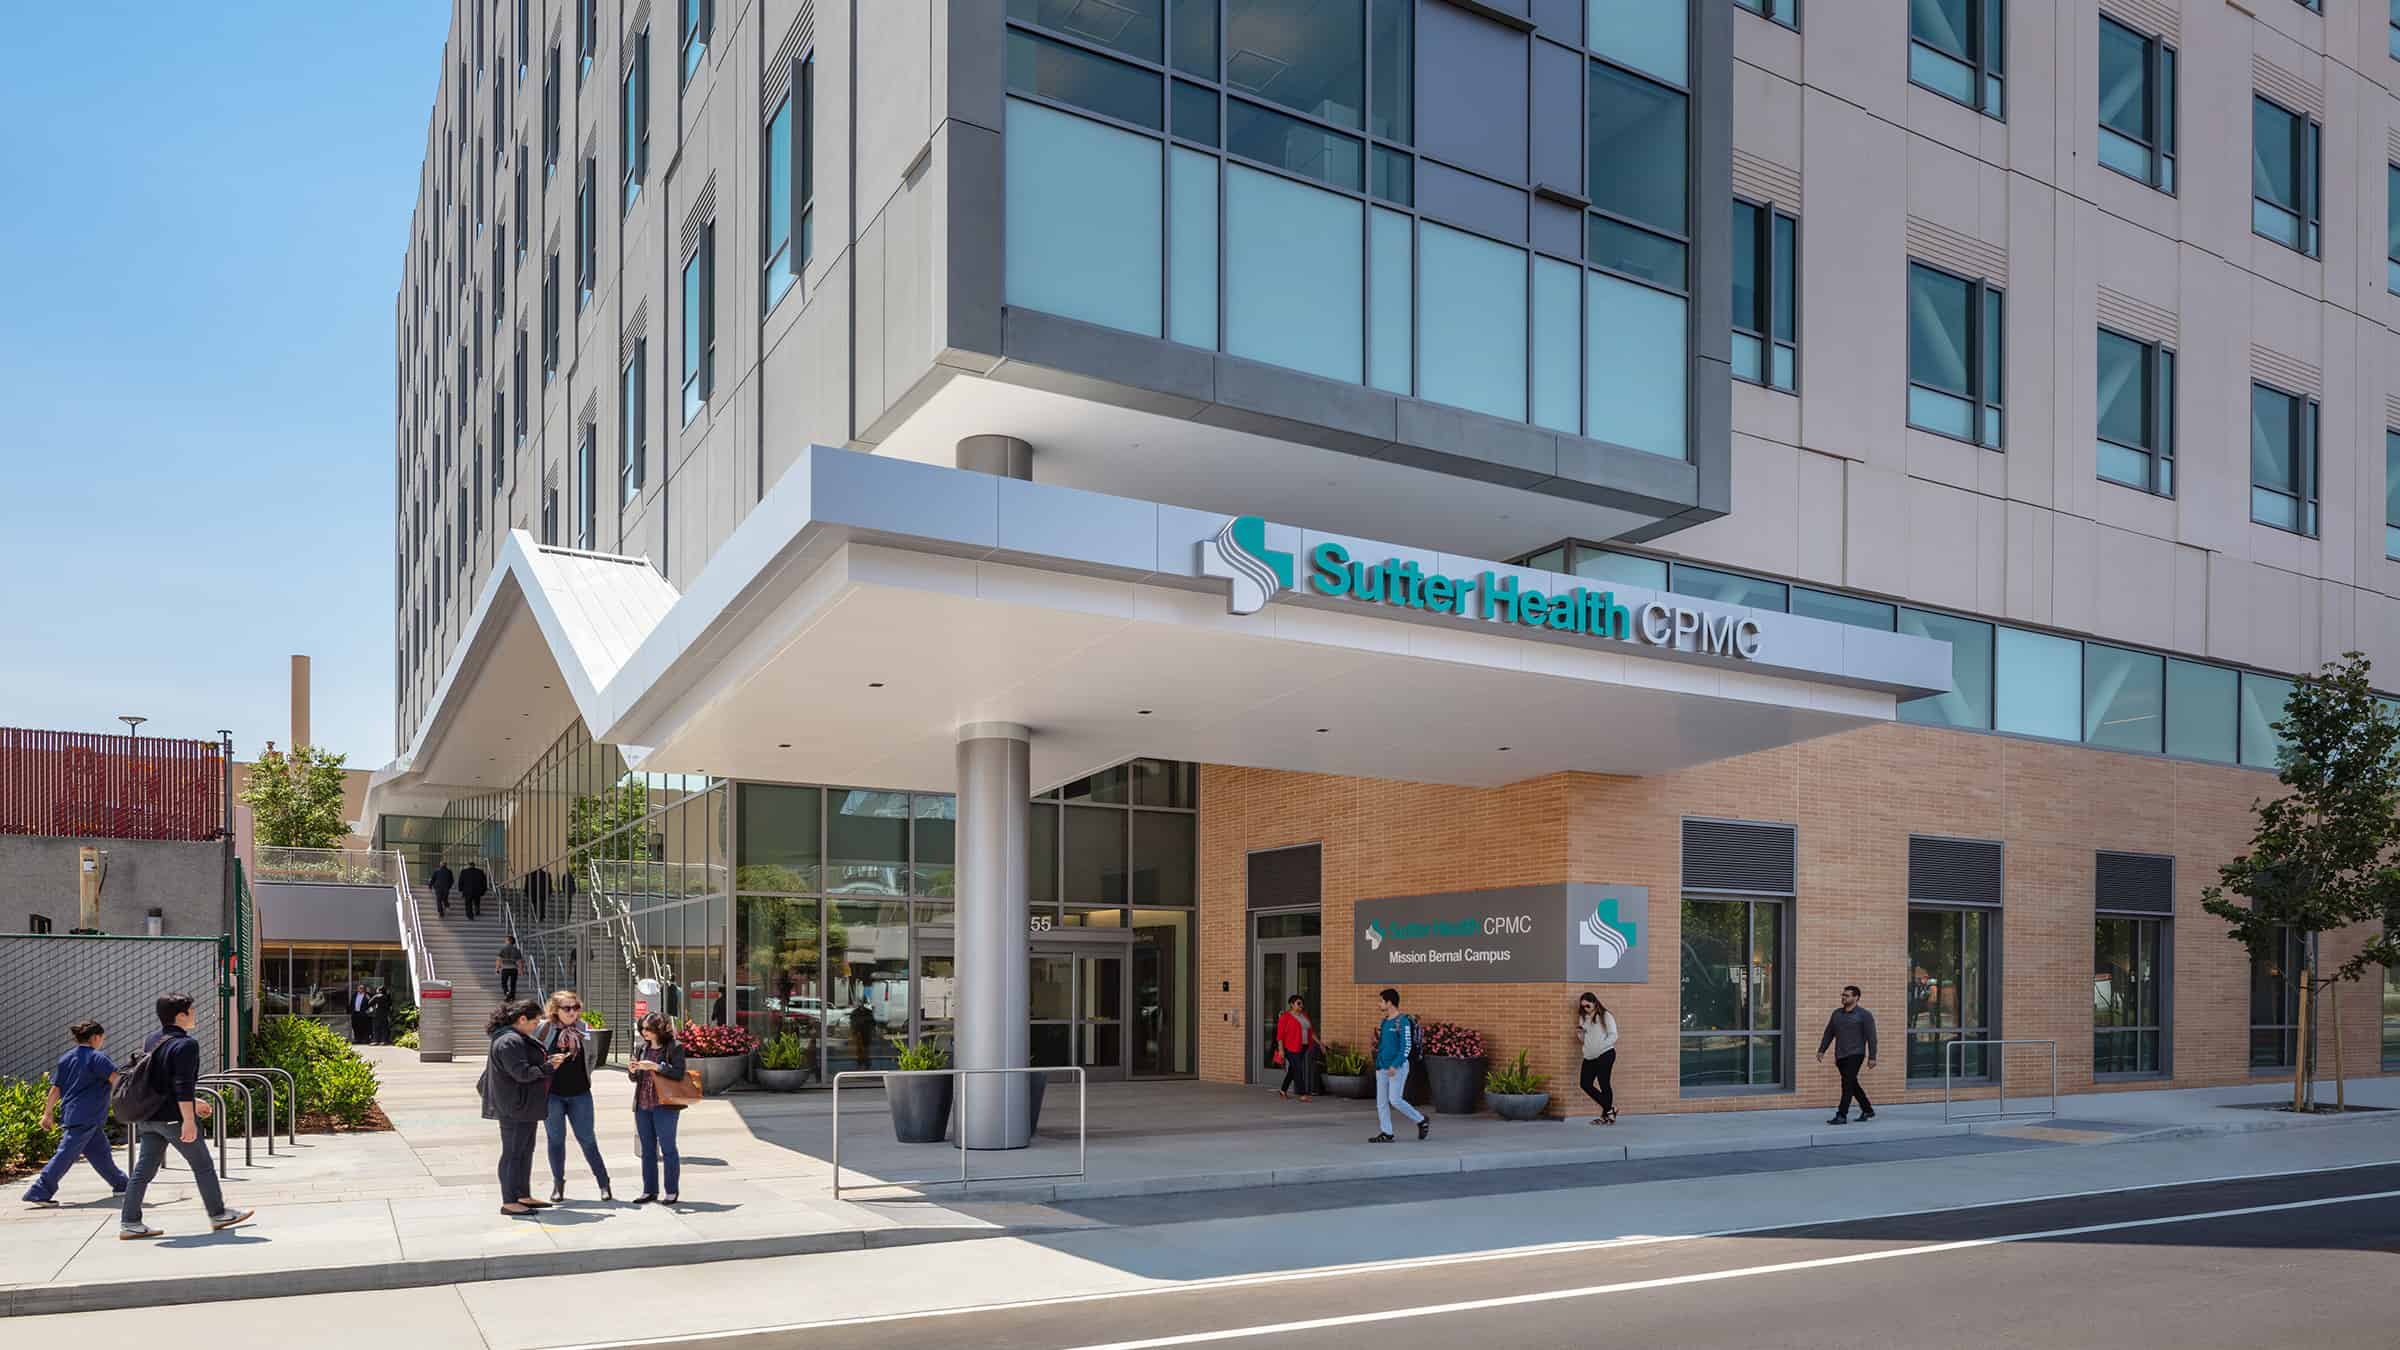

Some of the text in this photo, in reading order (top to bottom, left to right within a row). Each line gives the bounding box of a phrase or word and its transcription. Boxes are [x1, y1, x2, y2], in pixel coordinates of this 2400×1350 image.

[1311, 542, 1762, 659] Sutter Health CPMC
[1483, 914, 1532, 935] CPMC
[1389, 947, 1511, 964] Mission Bernal Campus
